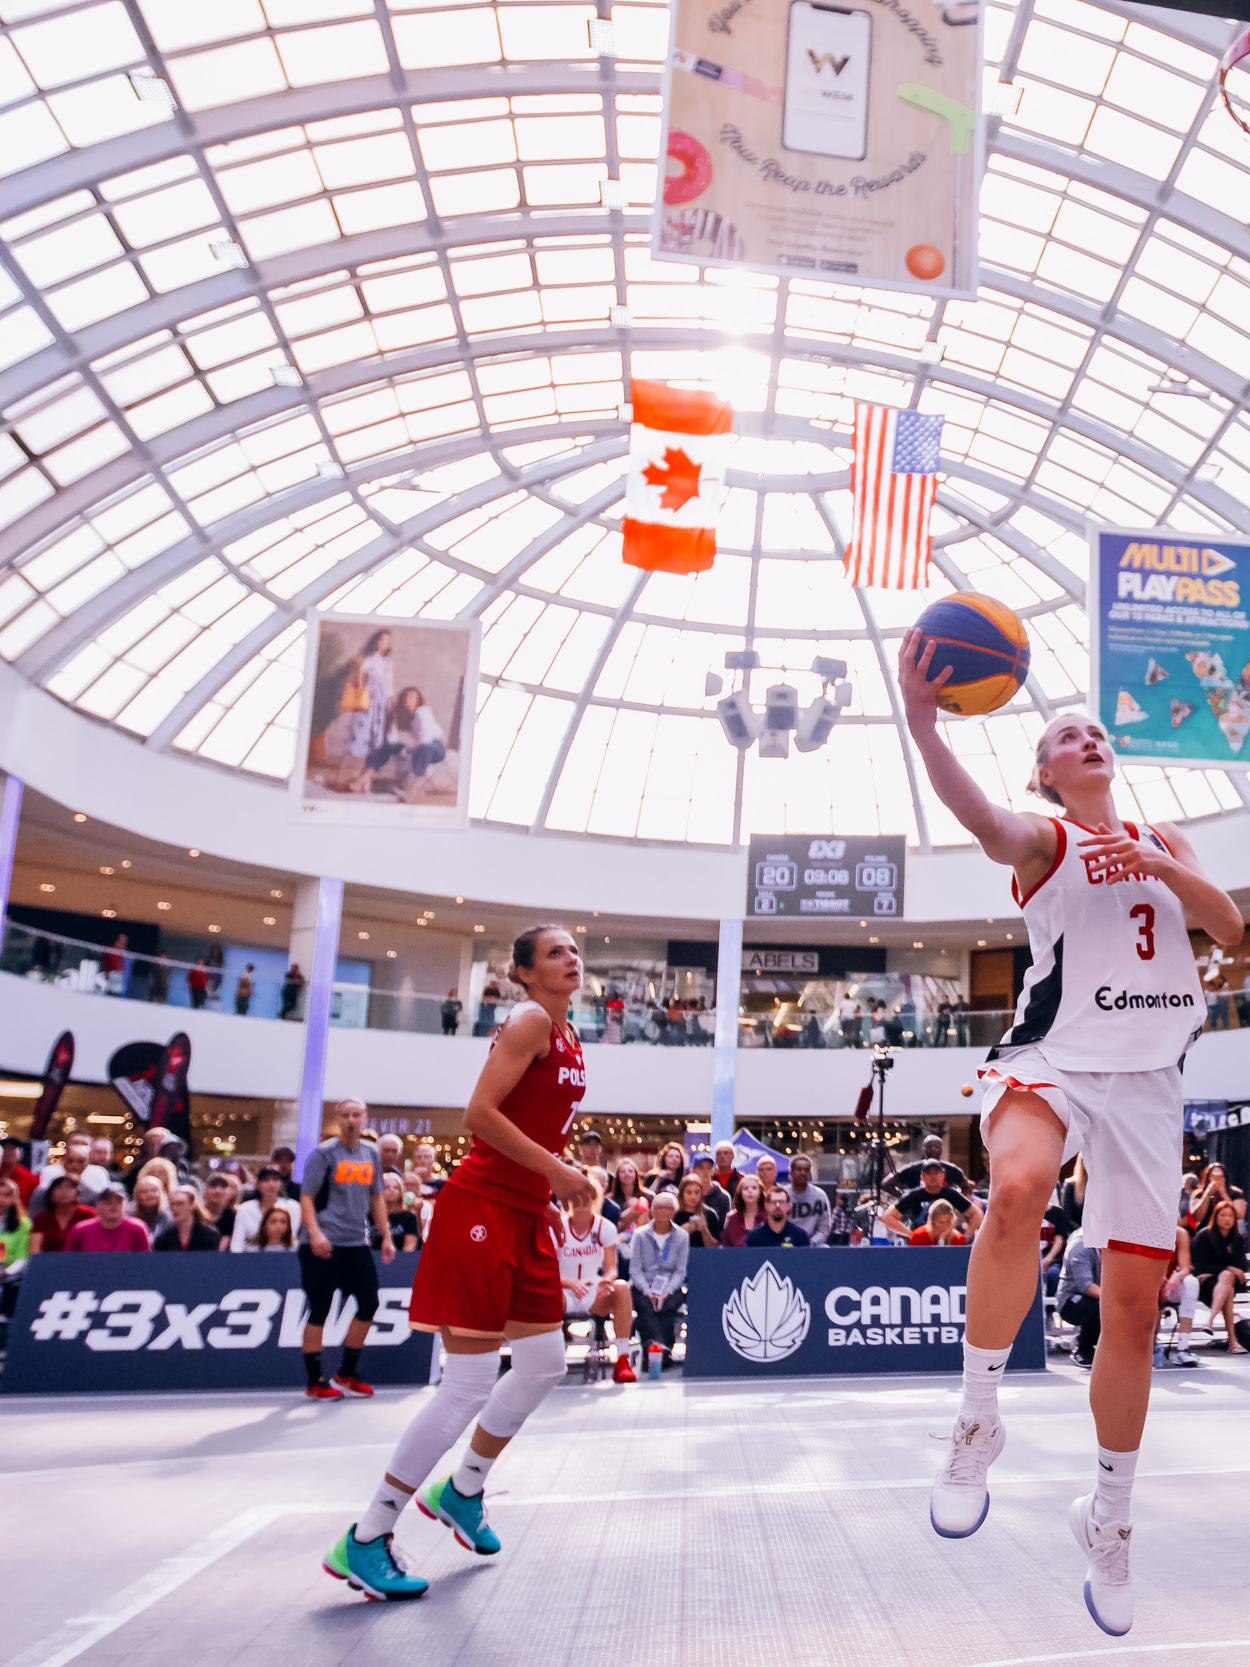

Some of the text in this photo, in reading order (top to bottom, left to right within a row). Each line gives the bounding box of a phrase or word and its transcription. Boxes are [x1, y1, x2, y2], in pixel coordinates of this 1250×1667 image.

[759, 158, 811, 193] Reap
[814, 179, 848, 196] the
[850, 151, 927, 199] Rewards
[1119, 542, 1199, 573] MULTI
[1117, 571, 1241, 608] PLAYPASS
[763, 866, 791, 886] 20
[862, 867, 891, 887] 08
[1129, 903, 1156, 961] 3
[748, 952, 816, 969] ABELS
[1094, 986, 1195, 1011] Edmonton
[558, 1066, 586, 1087] POLS
[414, 1119, 432, 1135] 21
[563, 1243, 597, 1258] CANADA
[577, 1263, 582, 1280] 1
[828, 1326, 965, 1347] BASKETB
